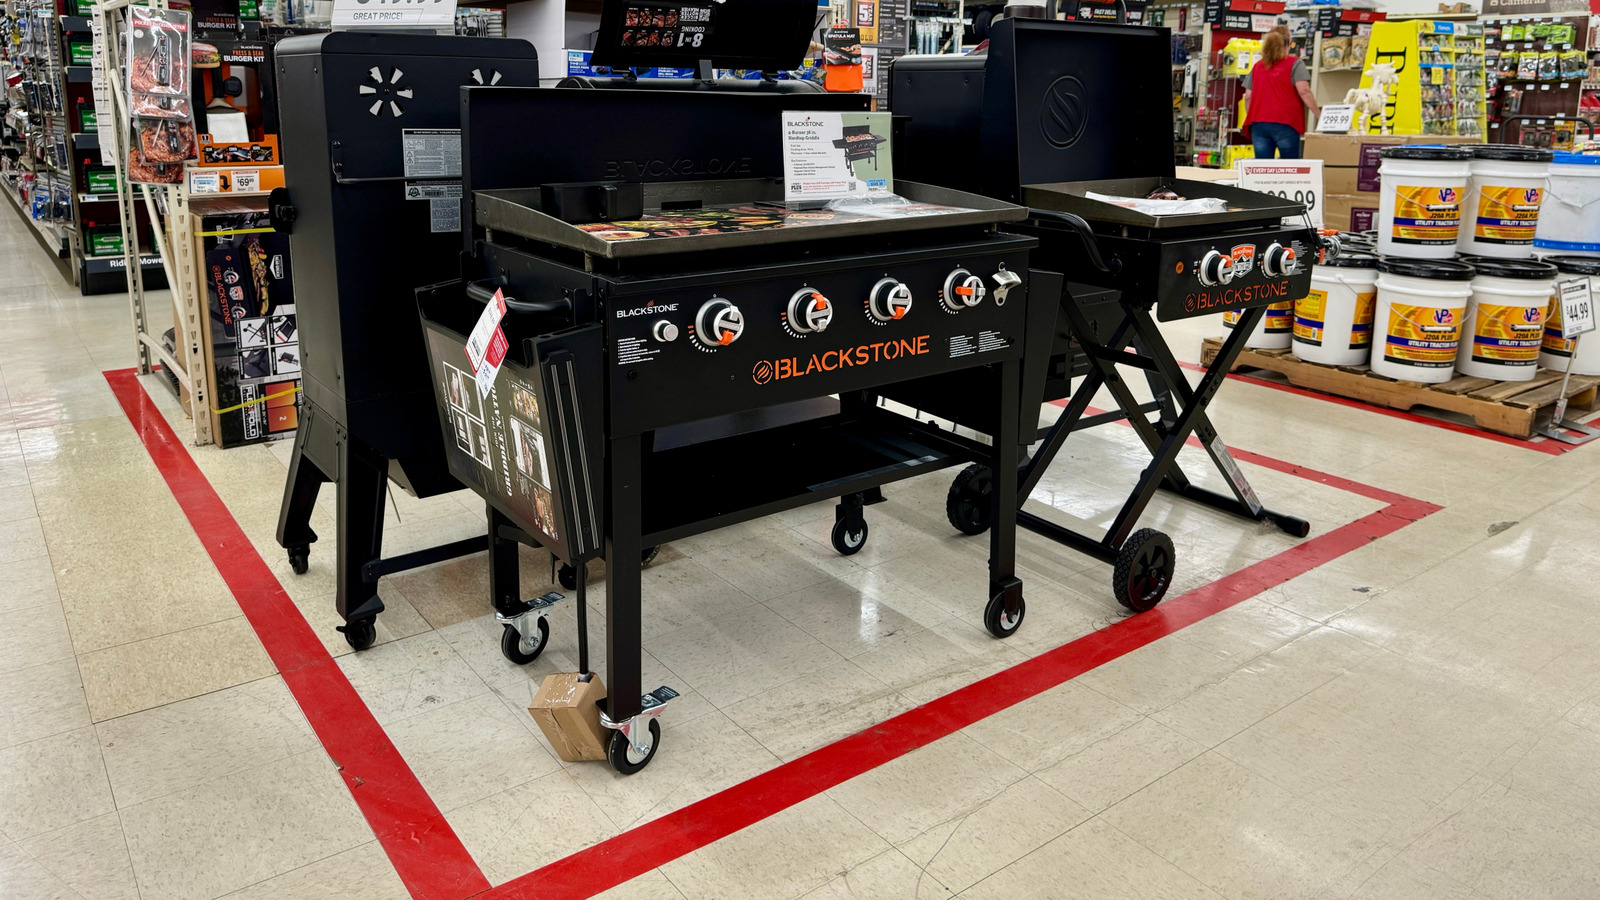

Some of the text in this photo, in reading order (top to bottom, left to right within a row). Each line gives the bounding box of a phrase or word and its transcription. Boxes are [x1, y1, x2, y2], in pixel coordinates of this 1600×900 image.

[353, 12, 403, 20] GREAT PRICE!
[859, 4, 867, 21] 5
[677, 32, 684, 47] 1
[692, 33, 704, 47] 8
[860, 34, 873, 42] OLD
[1440, 188, 1452, 202] VP
[1525, 188, 1537, 203] VP
[109, 257, 164, 268] Ridi Mowe
[213, 271, 232, 325] BLACKSTONE
[1197, 280, 1289, 310] BLACKSTONE
[616, 303, 678, 319] BLACKSTONE
[1435, 309, 1449, 323] VP
[1525, 307, 1538, 322] VP
[1566, 302, 1589, 322] $44.99
[774, 334, 931, 380] BLACKSTONE
[491, 385, 513, 497] GRIDDLE NATIO
